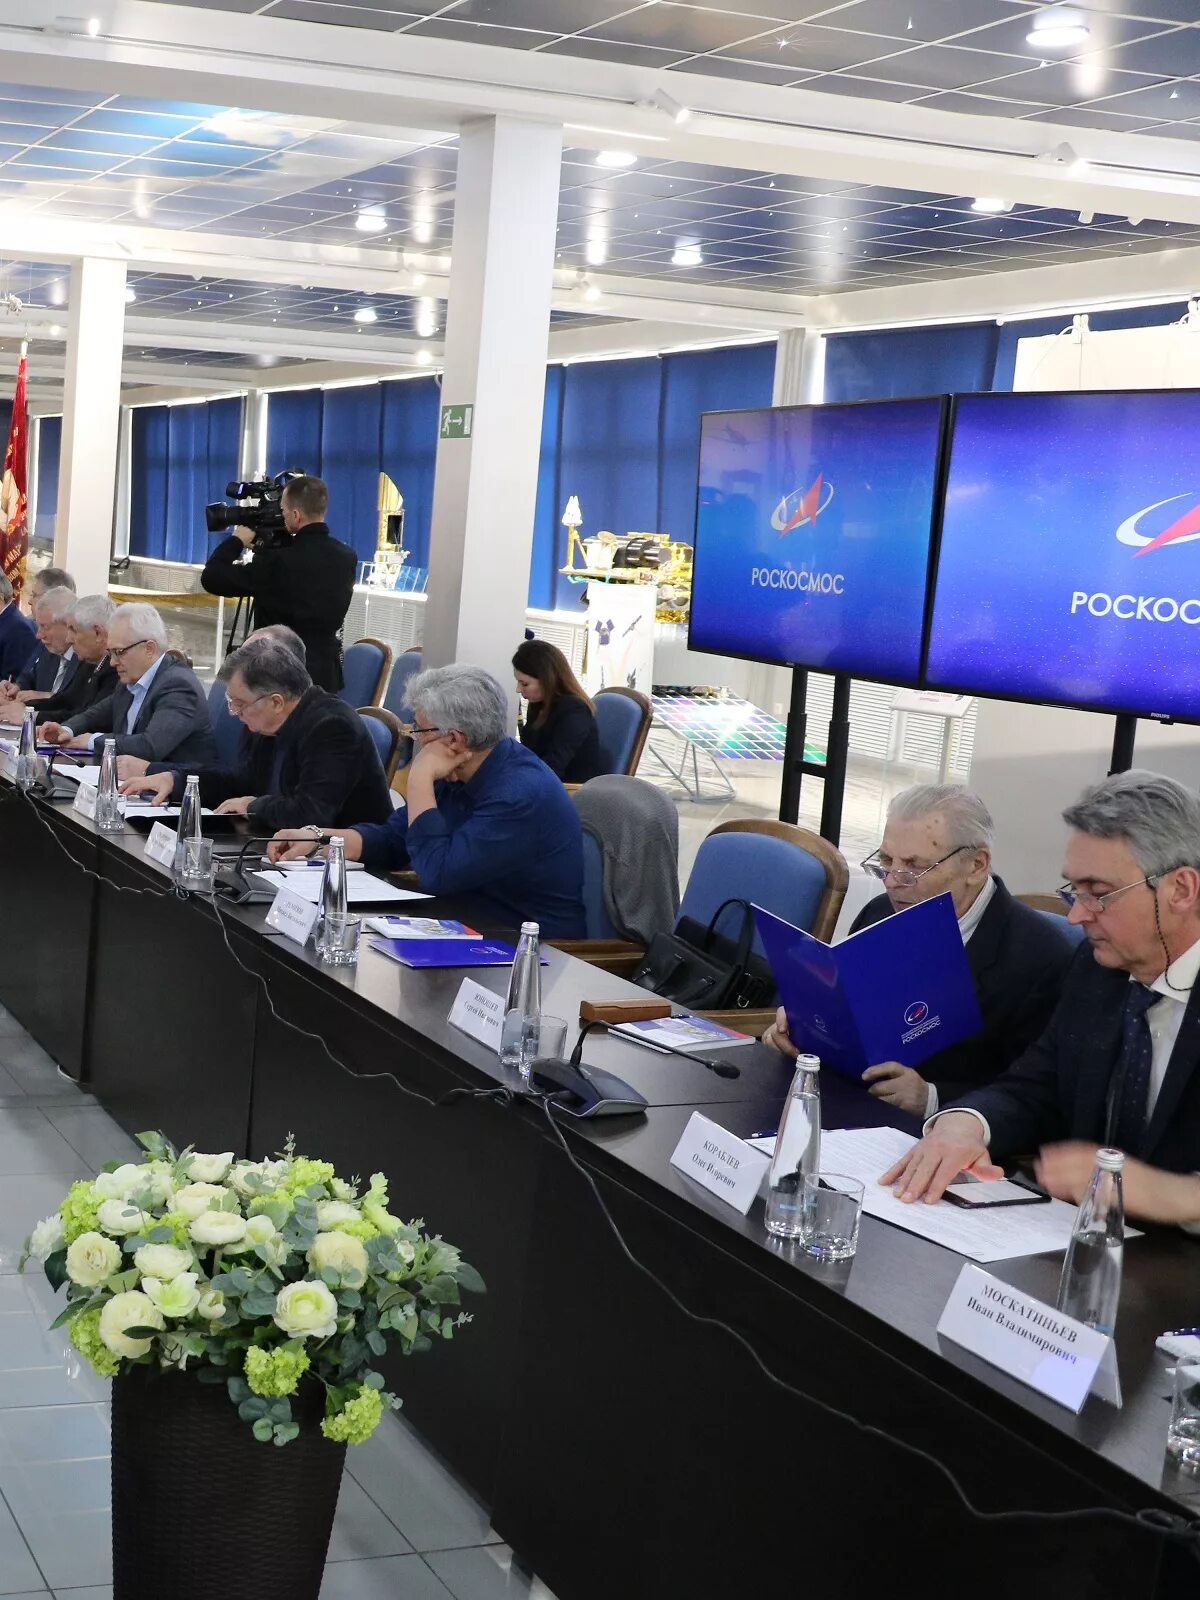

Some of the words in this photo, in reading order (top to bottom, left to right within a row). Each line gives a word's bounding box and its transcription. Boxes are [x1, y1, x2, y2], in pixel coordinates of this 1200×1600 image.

[751, 567, 845, 595] РОСКОСМОС
[1070, 591, 1200, 625] РОСКОС
[692, 1153, 705, 1169] Олег
[706, 1163, 736, 1189] Игоревич
[703, 1140, 740, 1169] КОРАБЛЕВ
[967, 1296, 994, 1319] Иван
[995, 1312, 1078, 1365] Владимирович
[981, 1284, 1079, 1343] МОСКАТИНЬЕВ
